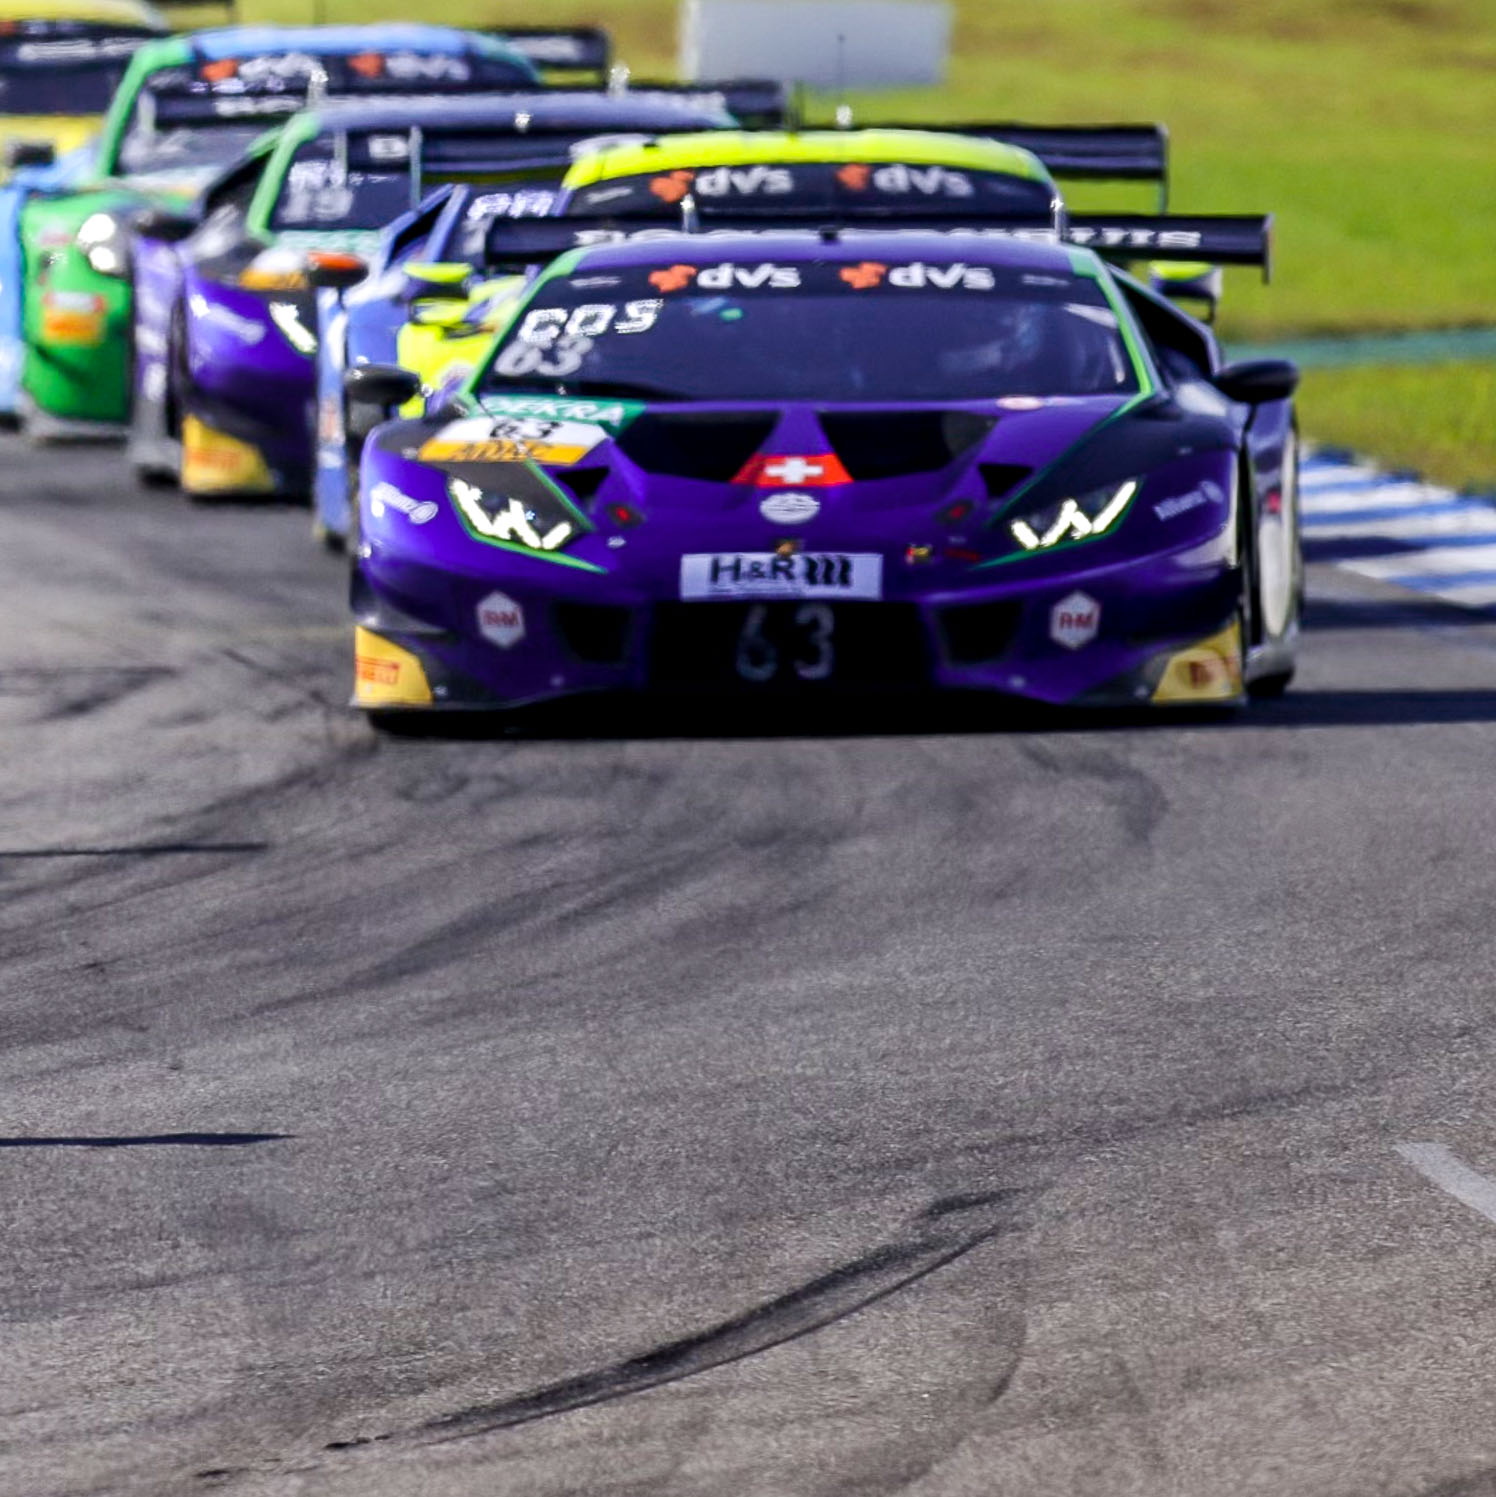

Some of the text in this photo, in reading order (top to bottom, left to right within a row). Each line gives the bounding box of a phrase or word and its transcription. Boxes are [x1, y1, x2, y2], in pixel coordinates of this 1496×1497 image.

[694, 164, 975, 197] dvs dvs
[697, 262, 994, 290] dvs dvs
[494, 335, 595, 377] 63
[711, 555, 798, 582] H&R
[737, 604, 836, 680] 63
